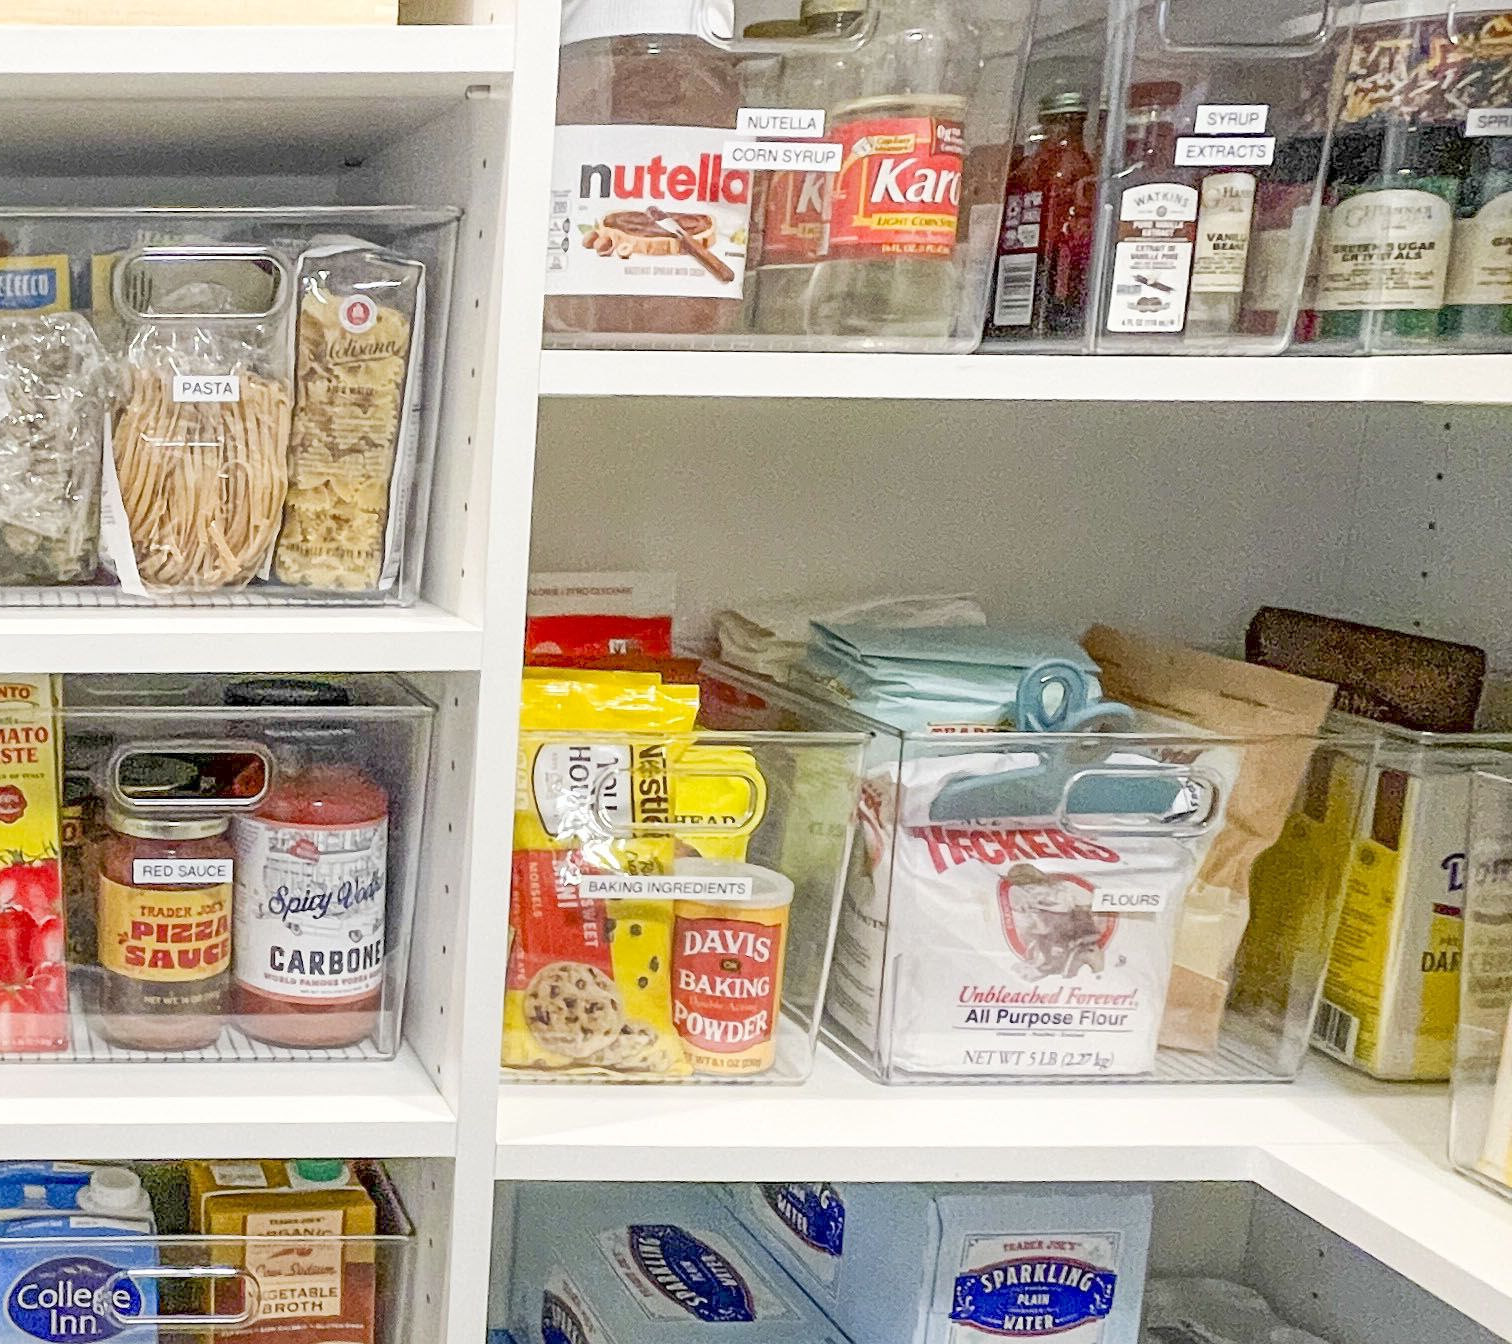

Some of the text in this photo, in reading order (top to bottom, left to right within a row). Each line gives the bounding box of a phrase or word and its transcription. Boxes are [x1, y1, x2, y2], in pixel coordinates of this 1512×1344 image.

[746, 115, 818, 131] NUTELLA
[1206, 112, 1260, 126] SYRUP
[731, 148, 837, 165] CORN SYRUP
[1186, 145, 1267, 159] EXTRACTS
[579, 153, 749, 204] nutella
[1134, 193, 1190, 209] WATKINS
[181, 381, 234, 395] PASTA
[142, 865, 227, 877] RED SAUCE
[587, 881, 747, 896] BAKING INGREDIENTS
[268, 885, 334, 922] Spicy
[1101, 894, 1160, 907] FLOURS
[140, 905, 192, 919] TRADER
[131, 915, 229, 944] PIZZA
[683, 929, 771, 960] DAVIS
[124, 937, 230, 970] SAUCE
[678, 970, 771, 999] BAKING
[958, 985, 1139, 1006] Unbleached Forever!
[674, 1005, 769, 1042] POWDER
[964, 1008, 1128, 1029] All Purpose Flour
[962, 1051, 1059, 1065] NET WT 5 LB
[1004, 1240, 1078, 1252] TRADER JOE'S
[979, 1263, 1095, 1294] SPARKLING
[17, 1280, 131, 1317] College
[1016, 1293, 1051, 1306] PLAIN
[262, 1300, 324, 1316] BROTH
[50, 1308, 97, 1335] Inn
[1002, 1314, 1055, 1331] WATER
